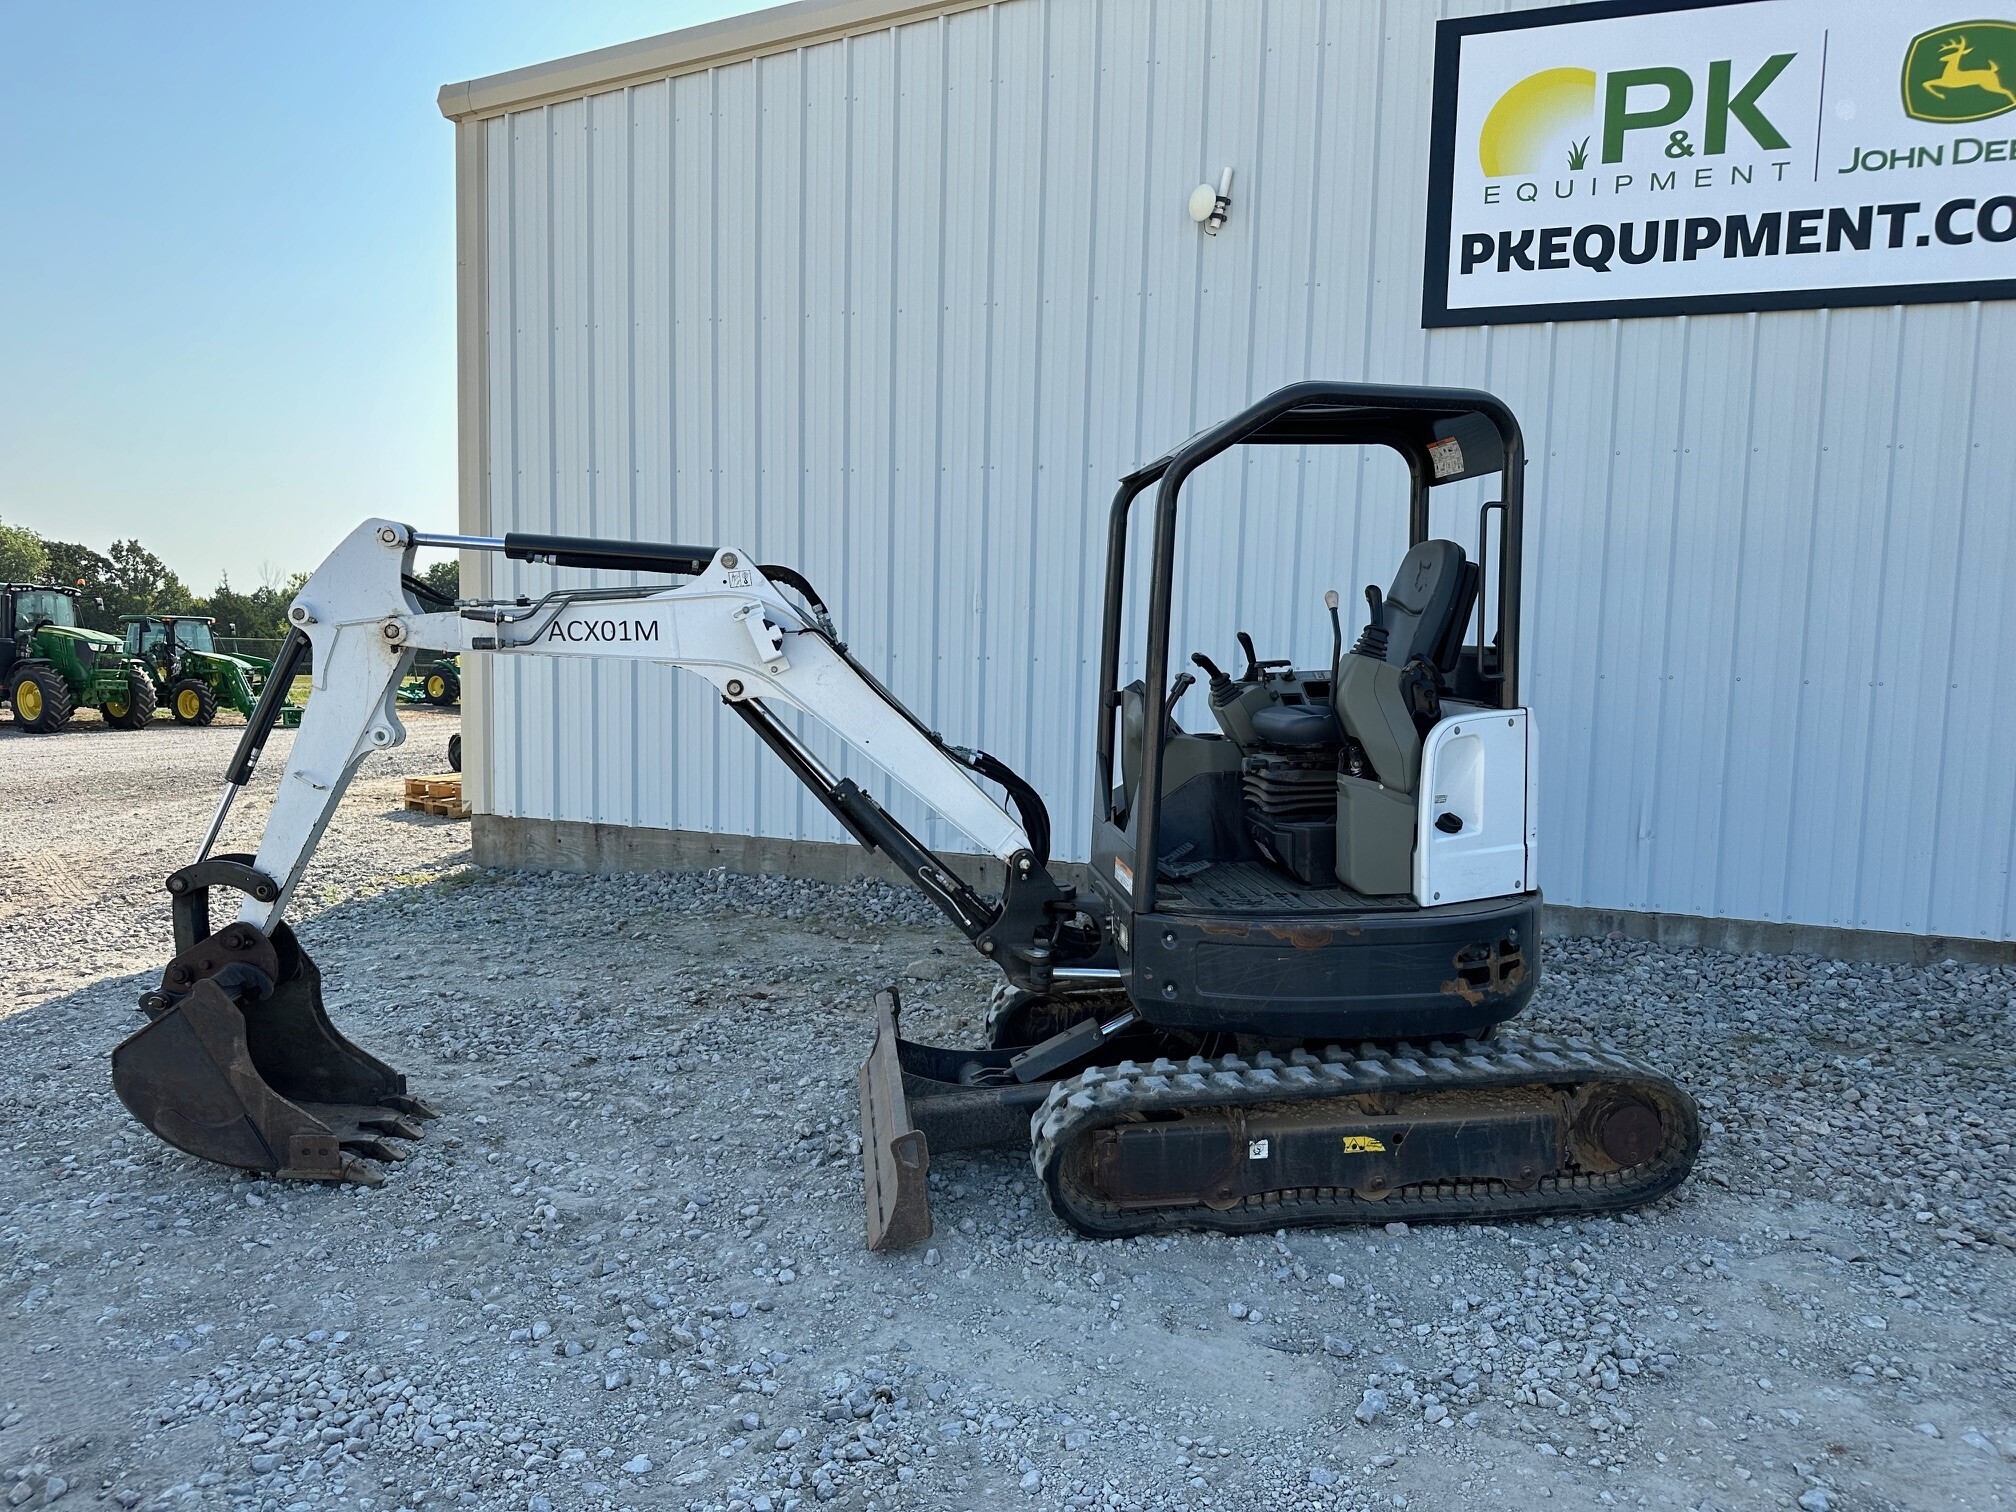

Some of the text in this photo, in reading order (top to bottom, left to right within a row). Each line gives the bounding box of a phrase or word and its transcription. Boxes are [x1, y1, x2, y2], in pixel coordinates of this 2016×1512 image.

[1601, 52, 1798, 164] P&K
[1838, 137, 2016, 174] JOHN DE
[1484, 161, 1791, 204] EQUIPMENT
[1460, 195, 2016, 275] PKEQUIPMENT.CO
[548, 620, 659, 641] ACX01M
